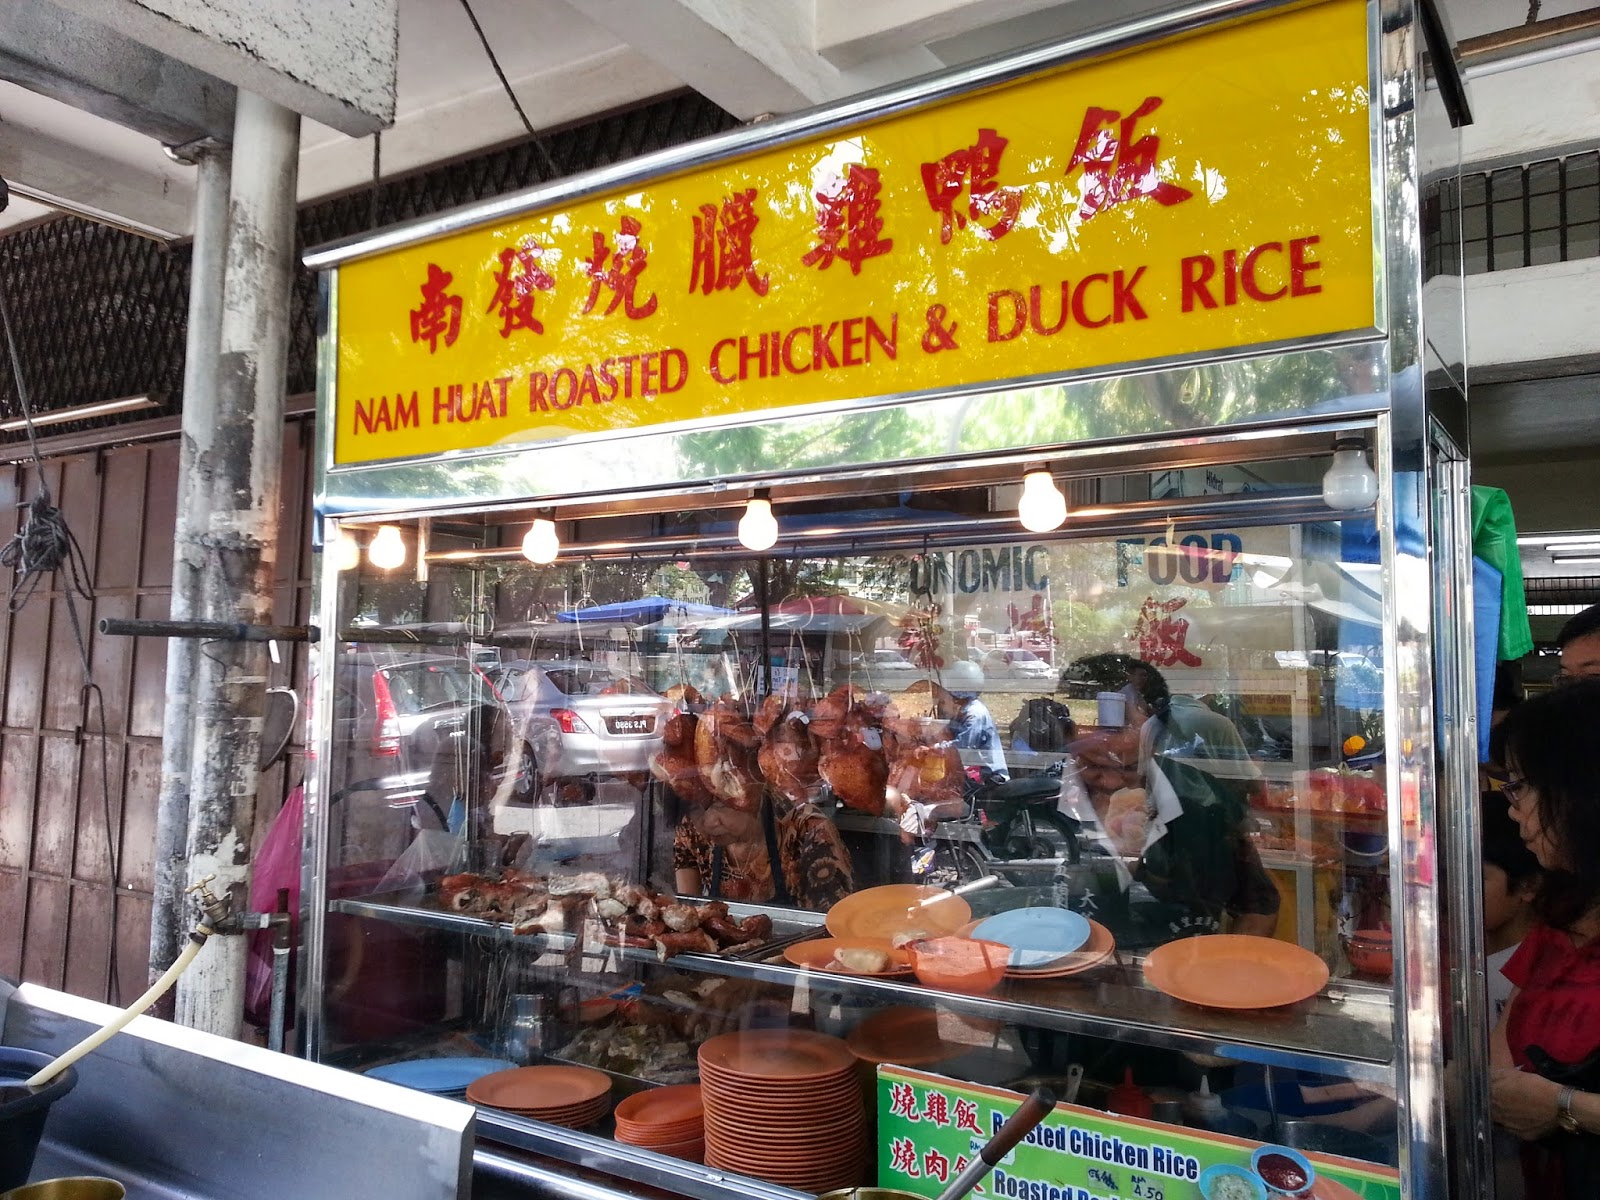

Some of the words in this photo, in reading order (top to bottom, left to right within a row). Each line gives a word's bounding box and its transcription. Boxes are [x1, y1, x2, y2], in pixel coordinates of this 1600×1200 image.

[353, 390, 420, 435] NAM
[432, 377, 514, 424] HUAT
[528, 347, 690, 413] ROASTED
[708, 312, 899, 385] CHICKEN
[920, 303, 959, 355] &
[986, 264, 1149, 344] DUCK
[1180, 234, 1323, 314] RICE
[888, 544, 1050, 597] ONOMIC
[1116, 532, 1243, 588] FOOD
[890, 1082, 984, 1135] 燒雞飯
[992, 1111, 1066, 1151] Rsted
[1069, 1129, 1149, 1170] Chicken
[1152, 1146, 1198, 1180] Rice
